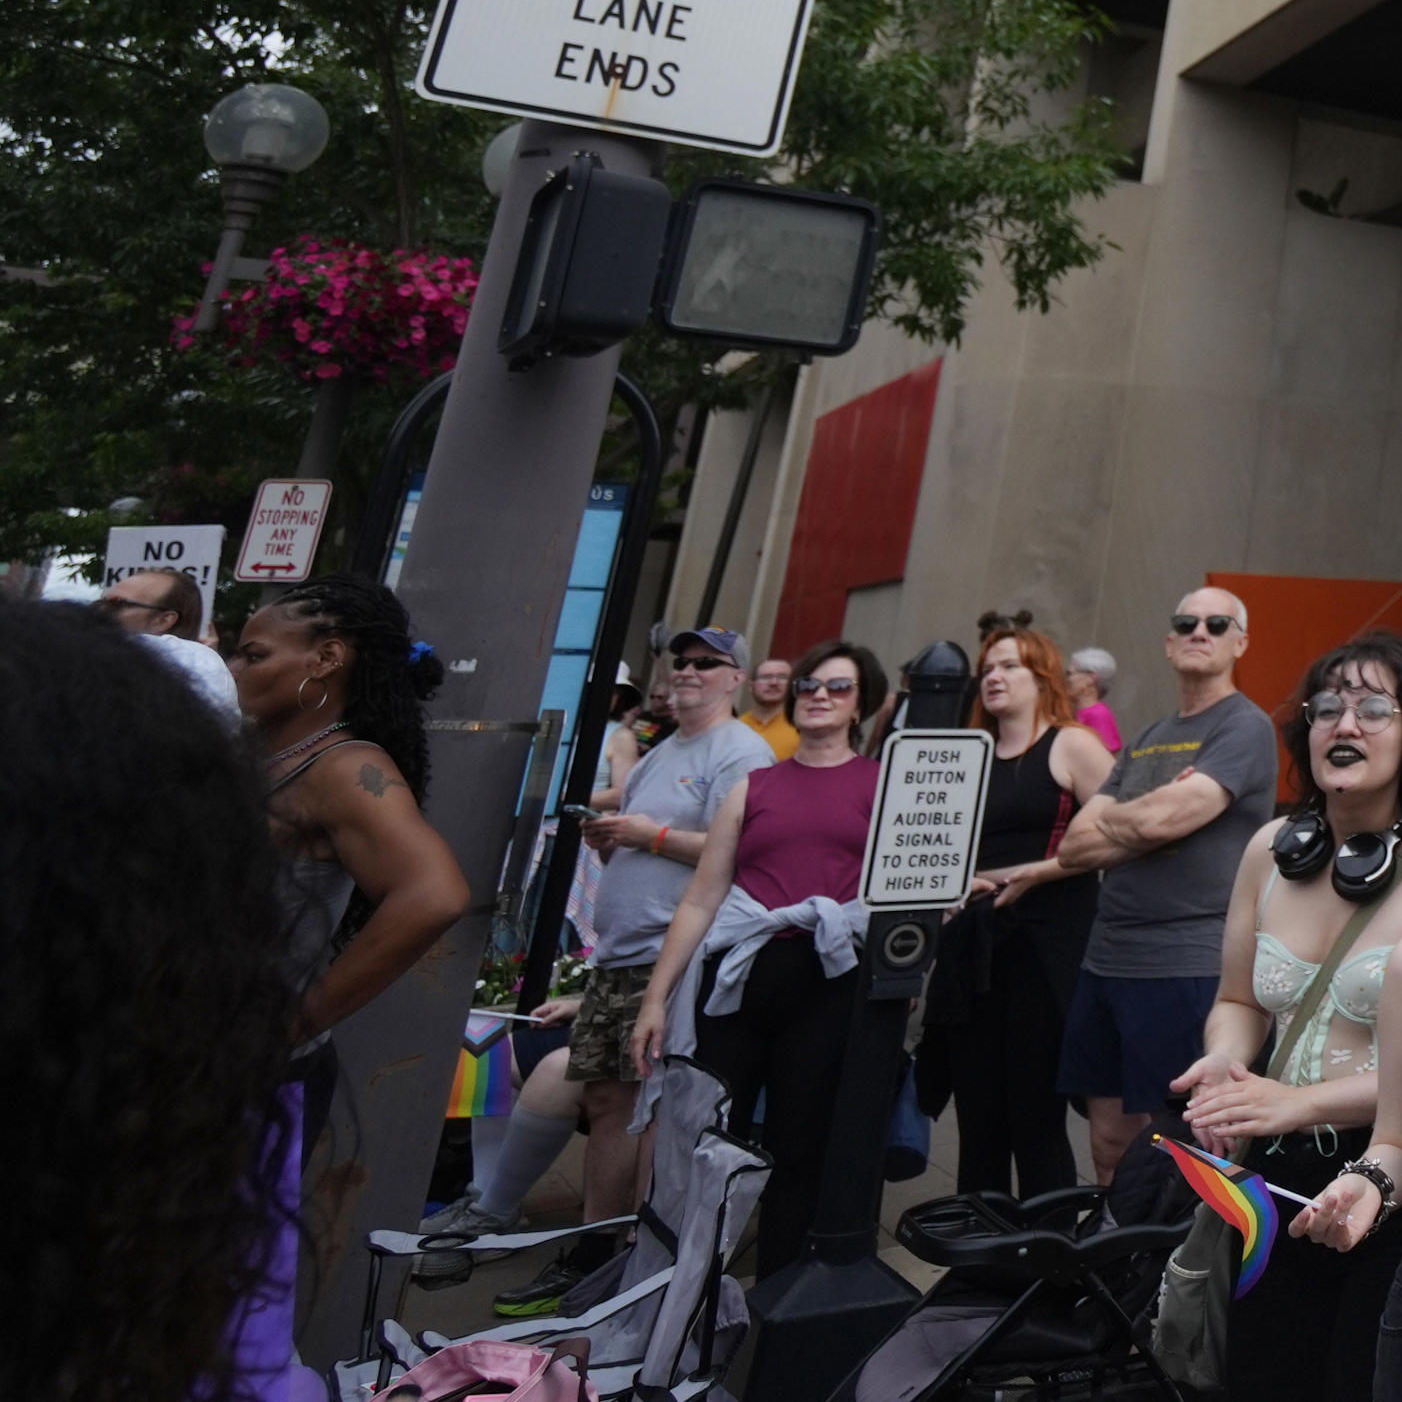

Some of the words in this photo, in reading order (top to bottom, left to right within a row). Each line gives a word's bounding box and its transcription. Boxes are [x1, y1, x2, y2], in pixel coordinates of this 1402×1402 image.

[554, 42, 681, 98] ENDS
[282, 490, 305, 506] NO
[257, 509, 319, 526] STOPPING
[270, 528, 298, 541] ANY
[144, 541, 185, 561] NO
[265, 543, 295, 557] TIME
[916, 750, 960, 764] PUSH
[904, 771, 966, 785] BUTTON
[915, 792, 947, 805] FOR
[893, 813, 963, 826] AUDIBLE
[895, 834, 953, 847] SIGNAL
[882, 855, 902, 868] TO
[908, 854, 960, 867] CROSS
[885, 876, 924, 891] HIGH
[929, 875, 948, 889] ST
